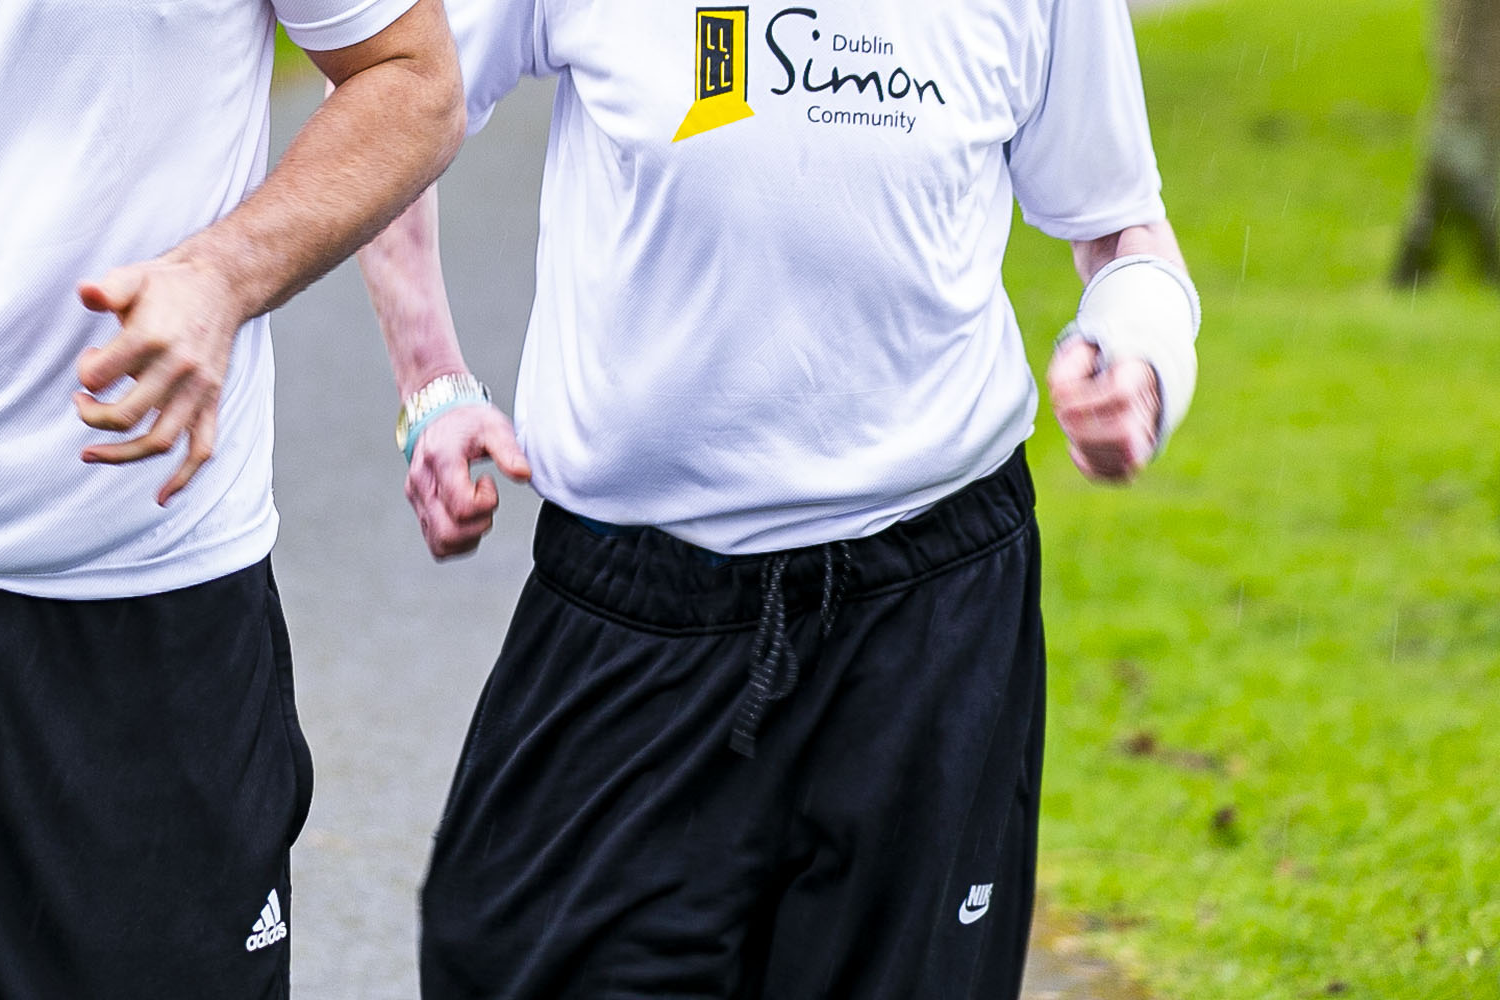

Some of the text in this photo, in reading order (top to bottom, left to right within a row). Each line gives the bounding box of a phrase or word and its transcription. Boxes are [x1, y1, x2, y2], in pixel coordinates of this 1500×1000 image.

[764, 6, 946, 105] Simon
[832, 33, 895, 56] Dublin
[806, 104, 918, 134] Community
[966, 882, 994, 907] NIK
[245, 921, 288, 953] adidas
